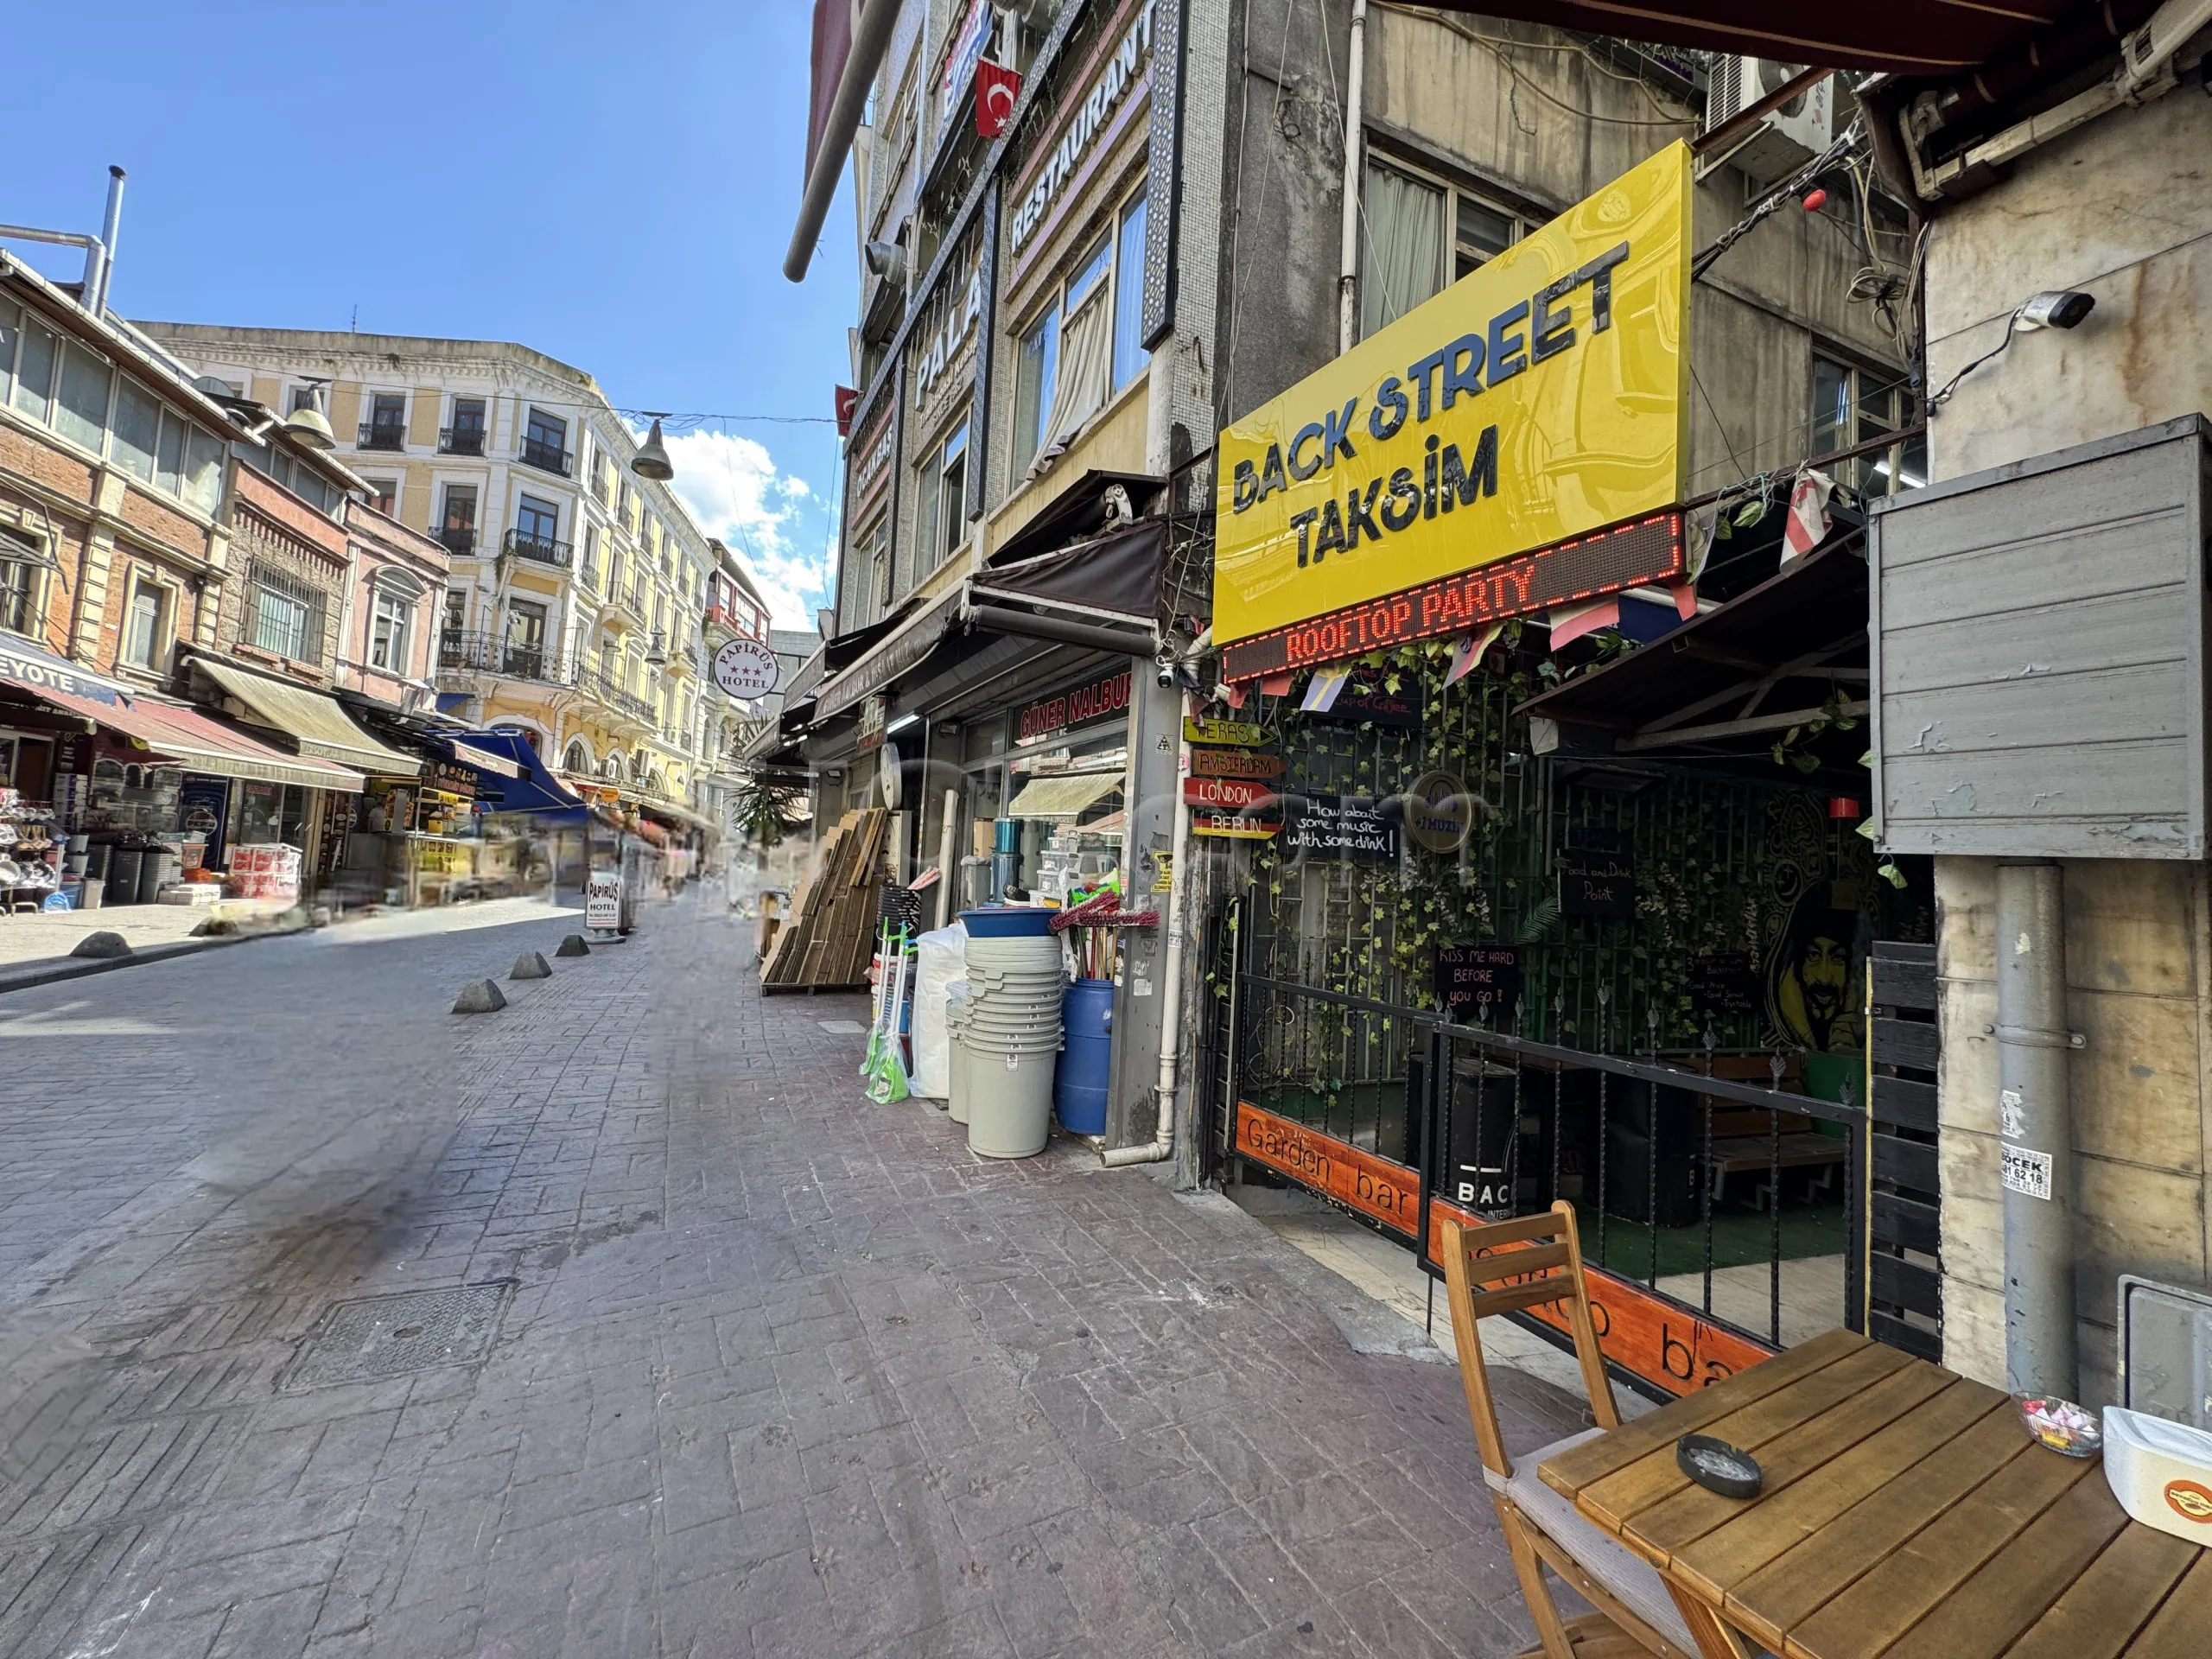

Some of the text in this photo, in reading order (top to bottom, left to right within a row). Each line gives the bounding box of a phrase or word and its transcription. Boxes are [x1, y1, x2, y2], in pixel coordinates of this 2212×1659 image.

[1012, 0, 1156, 254] RESTAURANT
[916, 270, 981, 411] PALA
[1233, 240, 1630, 516] BACK STREET
[1291, 424, 1499, 569] TAKSİM
[1287, 563, 1537, 663] ROOFTOP PARTY
[719, 642, 773, 671] PAPİRÜS
[721, 675, 769, 689] HOTEL
[1020, 698, 1065, 739] GÜNER
[1199, 753, 1272, 774] AMSTERDAM
[1198, 783, 1252, 804] LONDON
[1306, 798, 1340, 817] How
[1211, 815, 1262, 834] BERLIN
[1297, 817, 1382, 834] some music
[1287, 830, 1322, 849] with
[1322, 835, 1355, 848] some
[588, 881, 619, 902] PAPİRÜS
[1582, 880, 1615, 902] Point
[1440, 950, 1515, 965] KISS ME HARD
[1454, 968, 1494, 982] BEFORE
[1477, 990, 1492, 1002] GO
[1248, 1118, 1408, 1215] Garden bar
[2014, 1168, 2026, 1179] 62
[2030, 1173, 2043, 1185] 18
